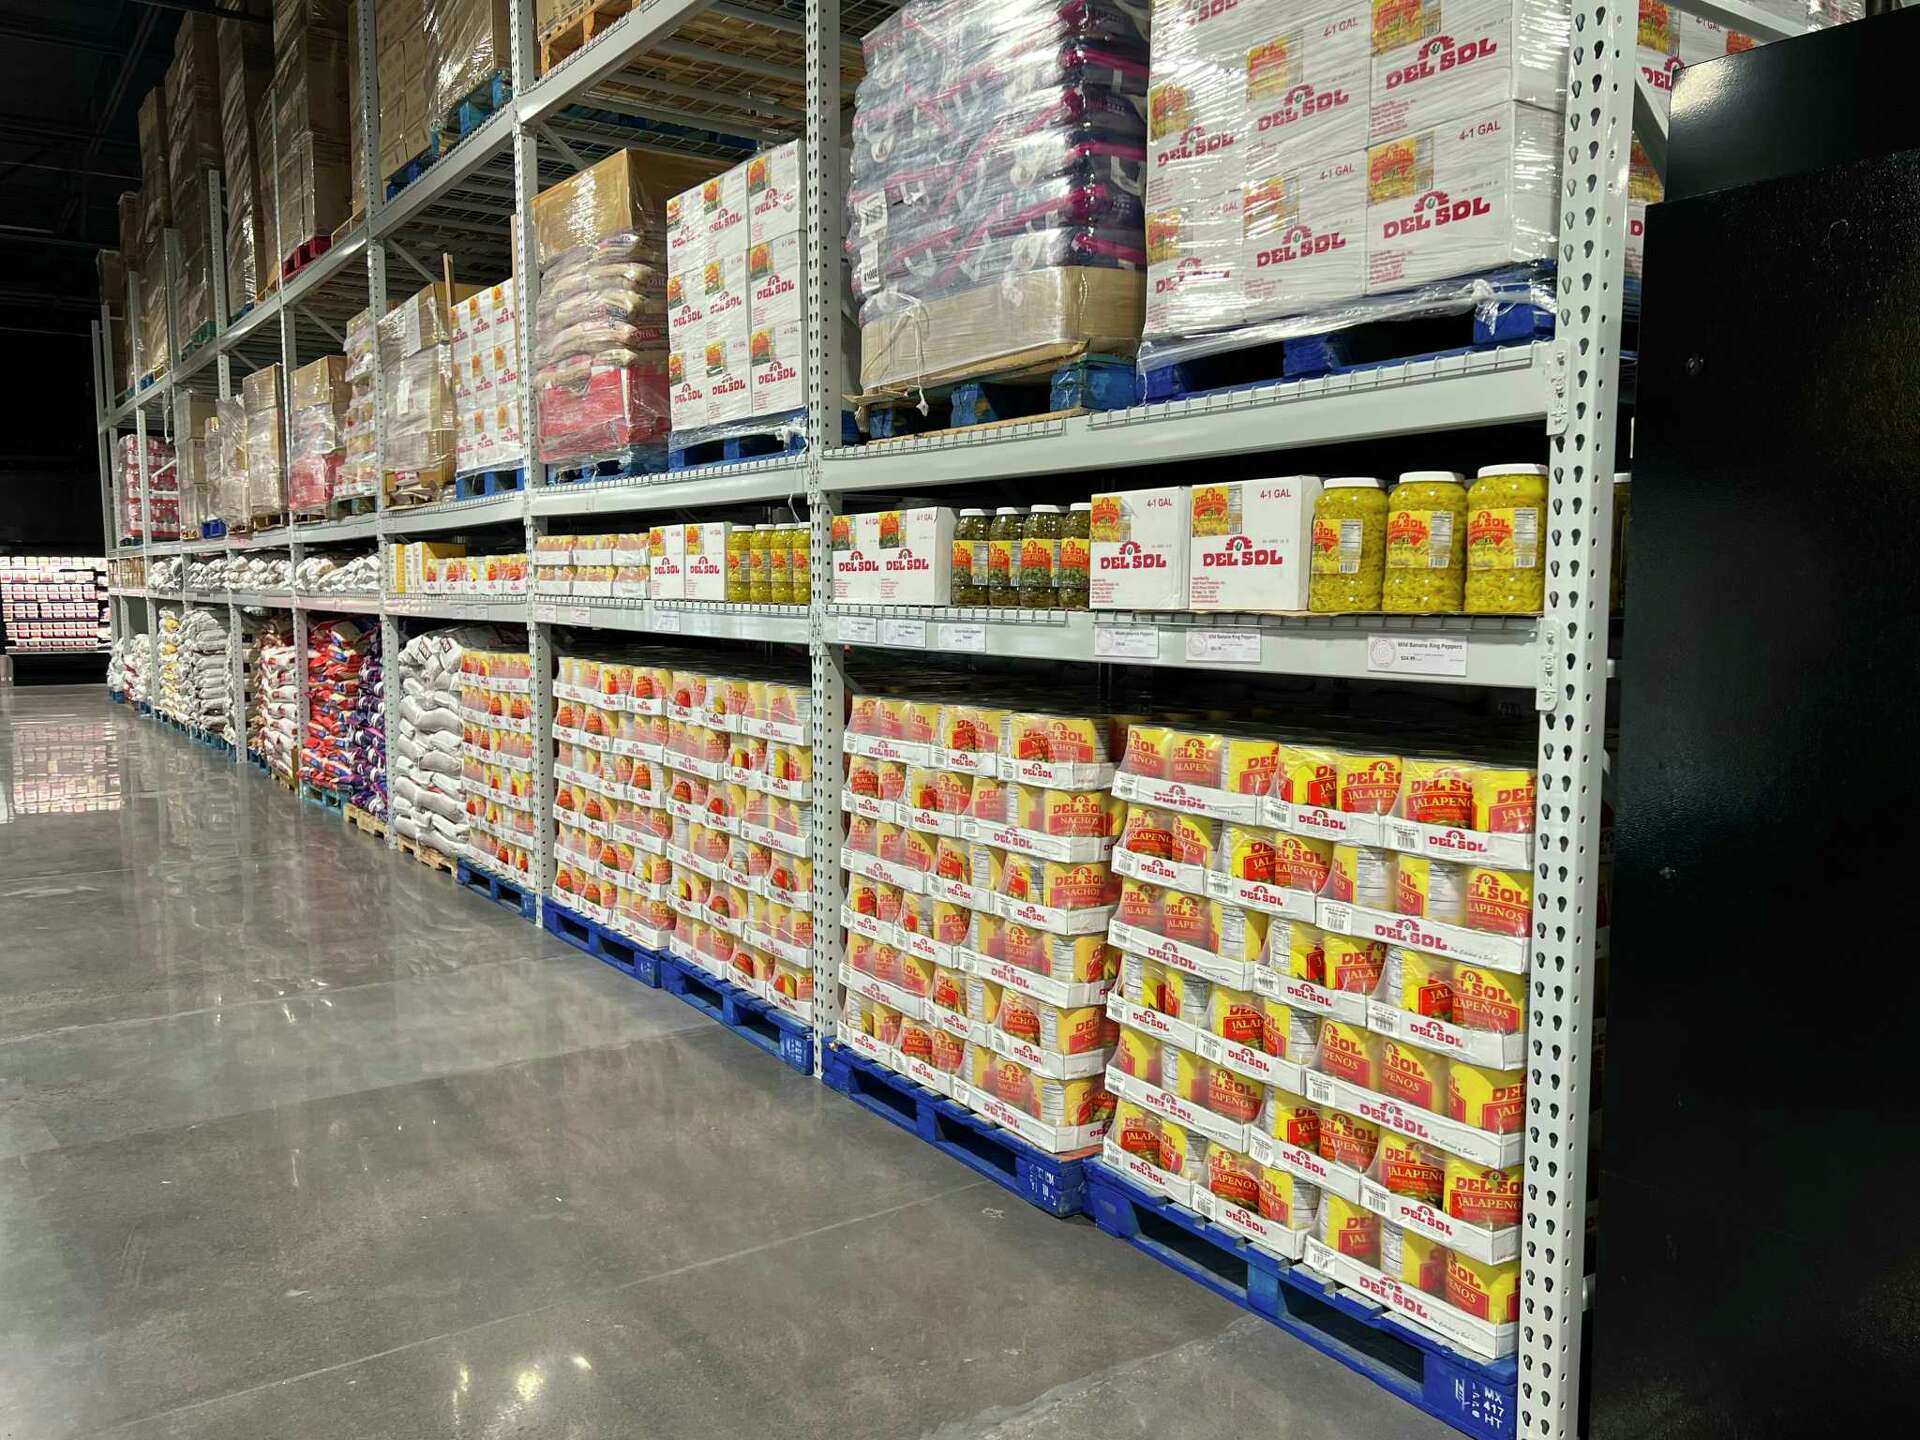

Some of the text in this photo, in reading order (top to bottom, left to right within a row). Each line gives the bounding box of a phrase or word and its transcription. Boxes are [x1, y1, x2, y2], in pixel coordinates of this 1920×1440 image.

[1386, 38, 1497, 90] DEL SOL
[1459, 120, 1501, 141] 4-1 GAL
[1383, 197, 1490, 239] DEL SOL
[1257, 232, 1346, 267] DEL SOL
[1158, 497, 1173, 507] GAL
[1260, 489, 1291, 499] 4-1 GAL
[1100, 553, 1167, 570] DEL SOL
[1203, 550, 1283, 567] DEL SOL
[1347, 771, 1381, 785] DEL
[1411, 779, 1446, 793] DEL
[1347, 789, 1399, 803] JALAPEN
[1054, 804, 1079, 814] DEL
[1299, 814, 1346, 831] DEL SOL
[1429, 836, 1487, 853] DEL SOL
[1292, 848, 1327, 865] SOL
[1056, 875, 1080, 886] DEL
[1240, 889, 1283, 907] DEL SOL
[1487, 886, 1529, 904] SOL
[1375, 924, 1448, 951] DEL SOL
[1148, 948, 1196, 970] DEL SOL
[1288, 985, 1332, 1007] DEL SOL
[1471, 983, 1512, 1003] SOL
[1133, 1012, 1169, 1032] DEL SOL
[1410, 1023, 1463, 1048] DEL SOL
[1228, 1051, 1269, 1072] DEL SOL
[1390, 1056, 1424, 1076] SOL
[1360, 1104, 1428, 1139] DEL SOL
[1283, 1151, 1326, 1177] DEL SOL
[1456, 1177, 1492, 1193] DEL
[1226, 1209, 1267, 1236] DEL SOL
[1401, 1206, 1453, 1236] DEL SOL
[1360, 1276, 1427, 1319] DEL SOL
